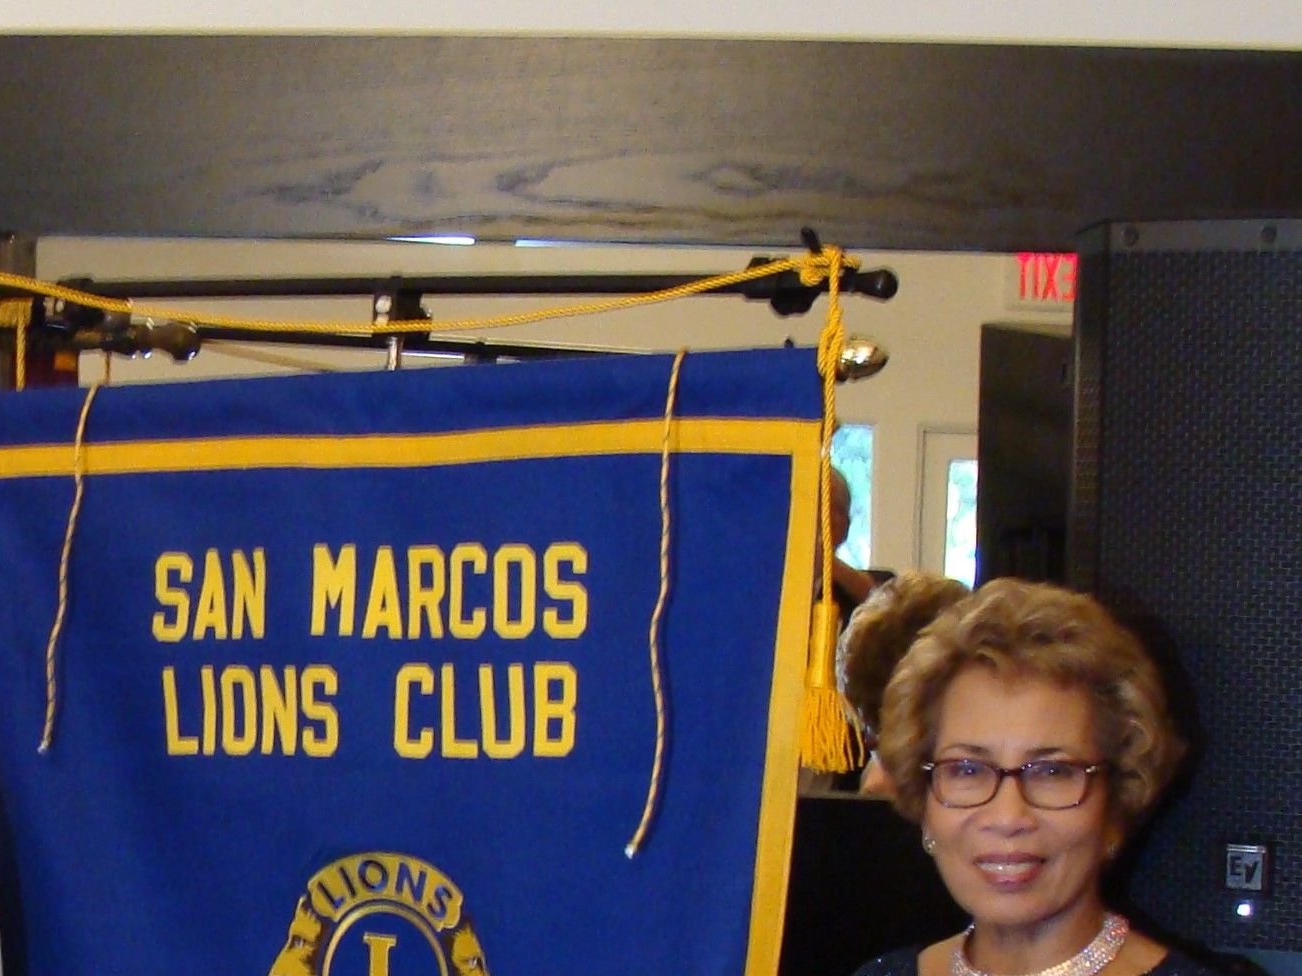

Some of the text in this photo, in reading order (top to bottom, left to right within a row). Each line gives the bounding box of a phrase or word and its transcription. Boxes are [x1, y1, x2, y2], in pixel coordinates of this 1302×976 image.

[152, 541, 589, 642] SAN MARCOS
[162, 661, 578, 759] LIONS CLUB
[316, 859, 455, 918] LIONS
